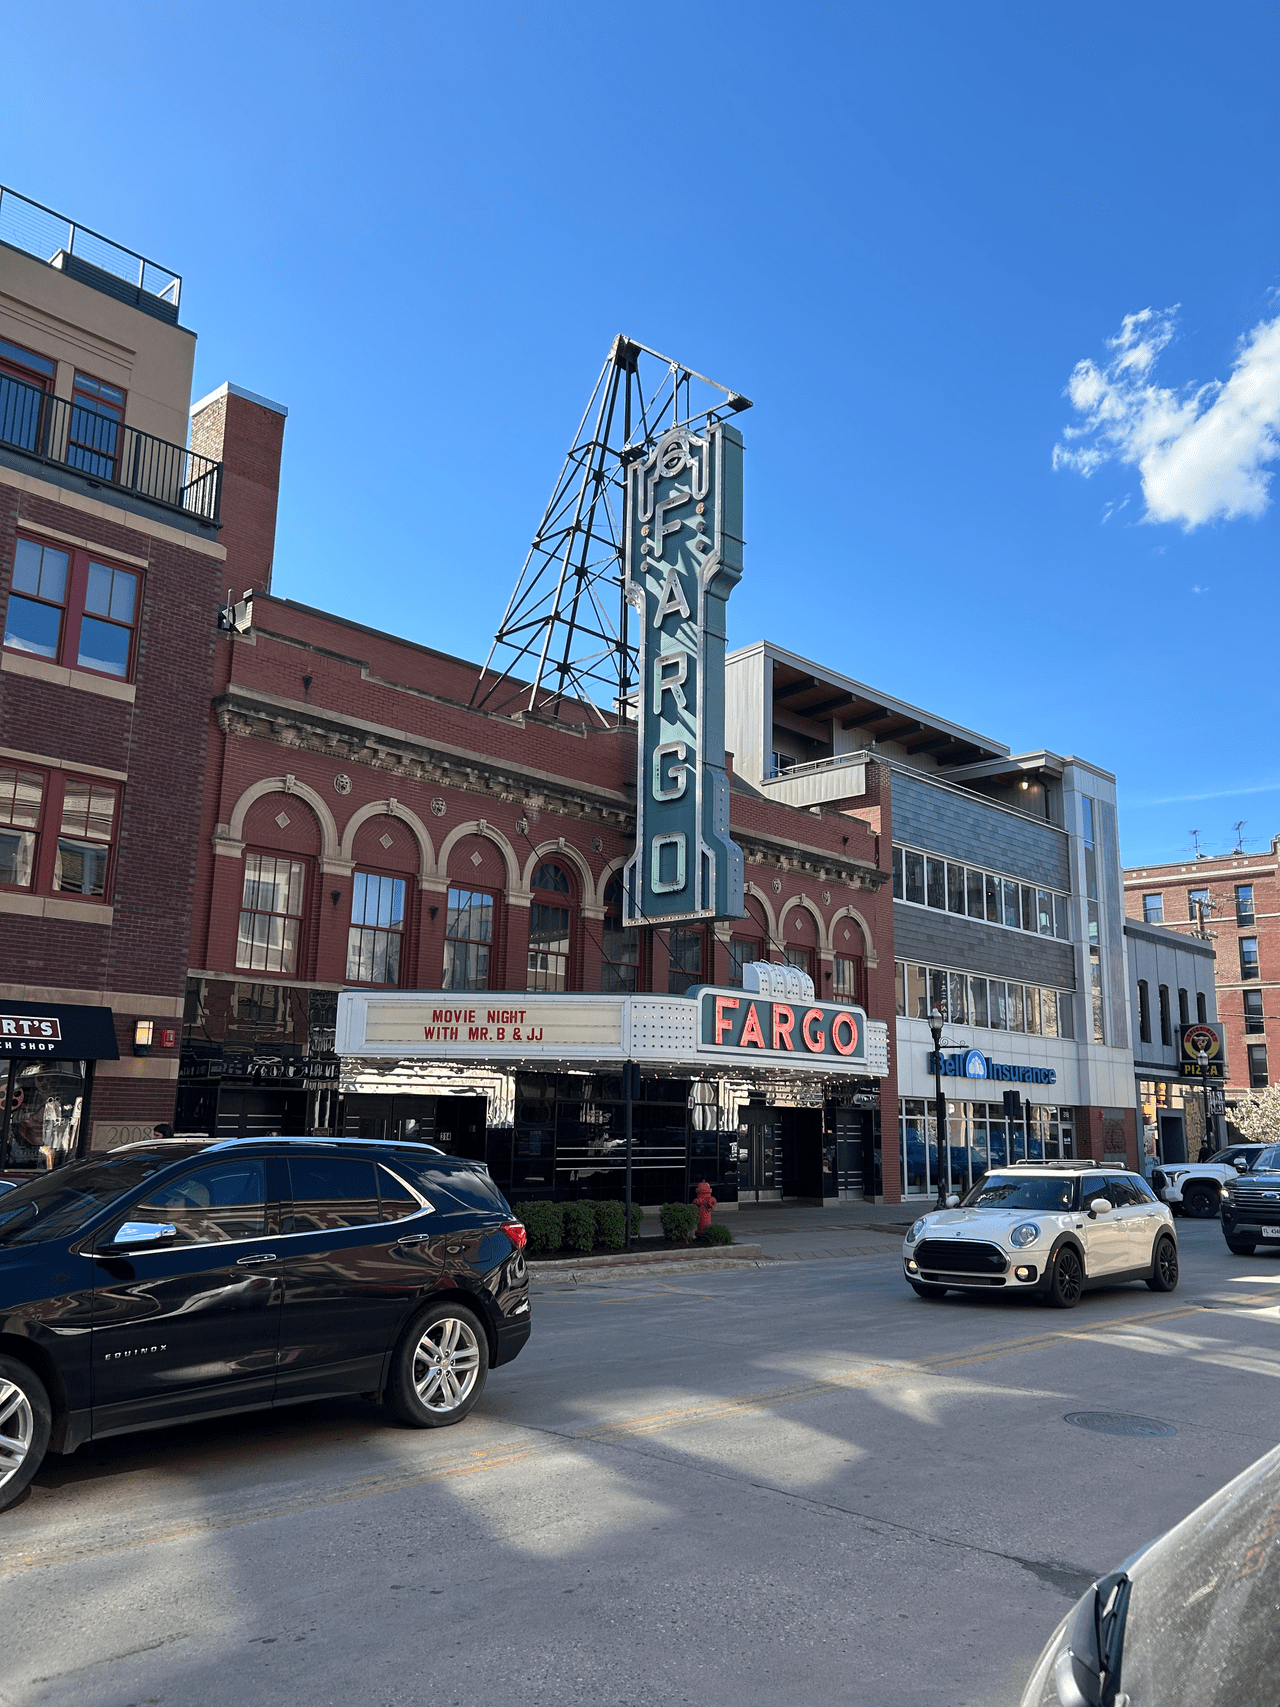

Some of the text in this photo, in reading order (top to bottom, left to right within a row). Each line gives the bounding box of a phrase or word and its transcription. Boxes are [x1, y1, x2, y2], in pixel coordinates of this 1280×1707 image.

[651, 491, 691, 895] FARGO
[432, 1009, 526, 1024] MOVIE NIGHT
[2, 1019, 53, 1036] RT'S
[424, 1026, 458, 1040] WITH
[512, 1027, 522, 1040] &
[526, 1027, 543, 1041] JJ
[714, 996, 858, 1056] FARGO
[20, 1042, 55, 1051] SHOP
[928, 1051, 1056, 1084] Bell Insurance
[107, 1126, 153, 1145] 2008
[104, 1344, 167, 1361] EQUINOX
